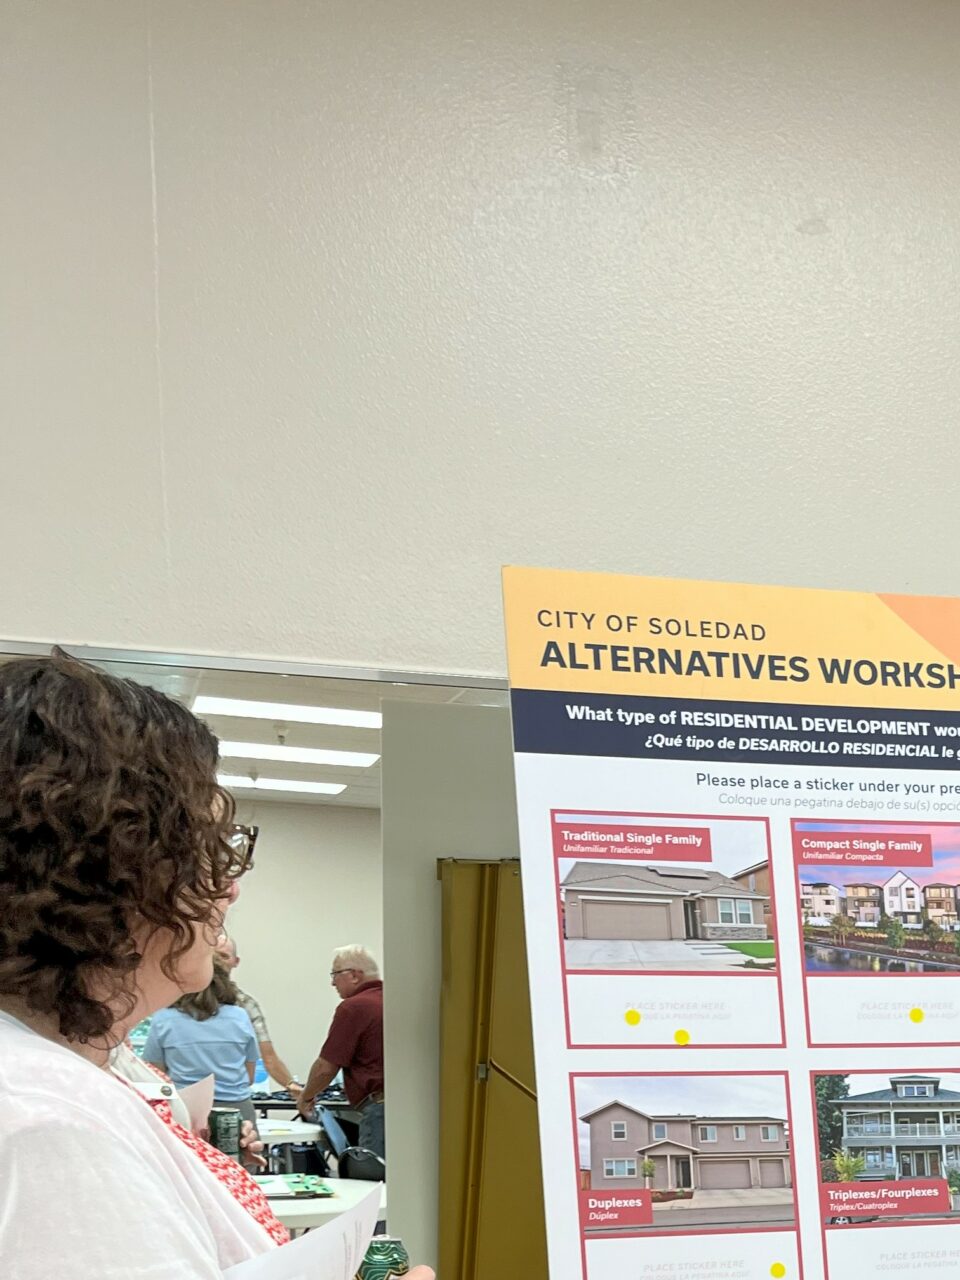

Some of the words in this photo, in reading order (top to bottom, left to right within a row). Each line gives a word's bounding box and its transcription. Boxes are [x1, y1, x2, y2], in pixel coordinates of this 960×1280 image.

[537, 610, 596, 630] CITY
[606, 614, 639, 633] OF
[649, 618, 766, 642] SOLEDAD
[540, 640, 810, 683] ALTERNATIVES
[566, 704, 614, 722] What
[617, 708, 655, 726] type
[659, 710, 677, 725] of
[681, 711, 798, 732] RESIDENTIAL
[801, 717, 931, 738] DEVELOPMENT
[644, 734, 683, 749] ¿Qué
[686, 735, 714, 751] tipo
[718, 737, 735, 750] de
[739, 737, 840, 756] DESARROLLO
[843, 742, 939, 759] RESIDENCIAL
[941, 746, 954, 758] le
[696, 773, 745, 788] Please
[750, 776, 789, 790] place
[794, 780, 802, 789] a
[806, 778, 854, 791] sticker
[859, 780, 901, 794] under
[904, 783, 937, 797] your
[718, 793, 767, 806] Coloque
[770, 798, 790, 806] una
[794, 798, 843, 809] pegatina
[846, 799, 884, 811] debajo
[886, 799, 901, 809] de
[903, 800, 930, 812] su(s)
[562, 830, 624, 843] Traditional
[627, 832, 662, 846] Single
[665, 834, 702, 847] Family
[563, 844, 607, 854] Unifamiliar
[610, 846, 654, 855] Tradicional
[801, 839, 850, 852] Compact
[852, 840, 886, 852] Single
[888, 841, 923, 854] Family
[802, 851, 844, 861] Unifamiliar
[846, 853, 884, 863] Compacta
[828, 1187, 940, 1202] Triplexes/Fourplexes
[588, 1197, 642, 1210] Duplexes
[829, 1202, 899, 1213] Triplex/Cuatroplex
[589, 1211, 619, 1223] Dúplex
[643, 1262, 674, 1272] PLACE
[678, 1260, 718, 1271] STICKER
